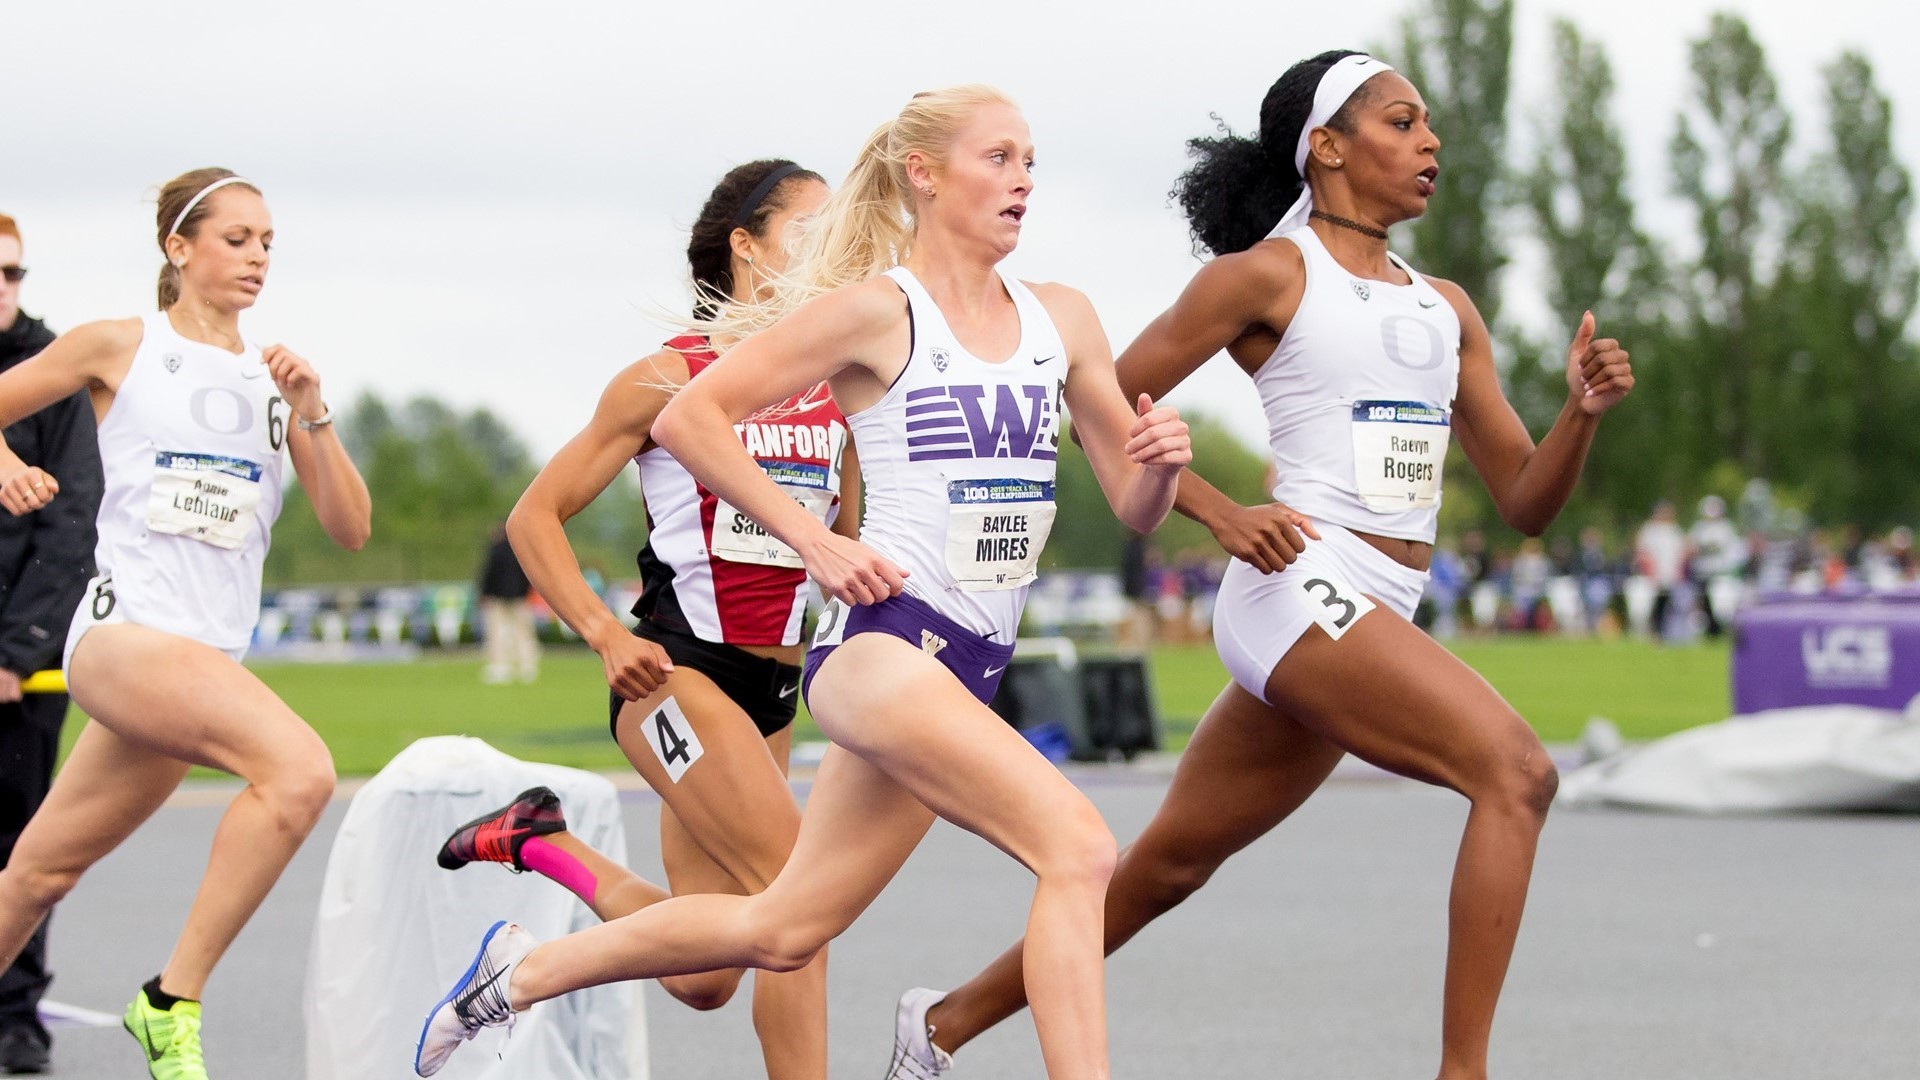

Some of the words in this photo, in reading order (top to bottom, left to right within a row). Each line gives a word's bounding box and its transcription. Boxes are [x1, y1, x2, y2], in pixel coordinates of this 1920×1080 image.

[268, 396, 282, 451] 6
[948, 384, 1048, 458] W
[1368, 406, 1396, 420] 100
[733, 423, 831, 460] TANFOR
[1391, 435, 1429, 455] Raevyn
[1384, 456, 1433, 482] Rogers
[963, 487, 989, 501] 100
[982, 515, 1028, 533] BAYLEE
[767, 549, 778, 559] W
[976, 537, 1029, 562] MIRES
[996, 573, 1006, 584] W
[1303, 578, 1357, 630] 3
[655, 709, 691, 766] 4
